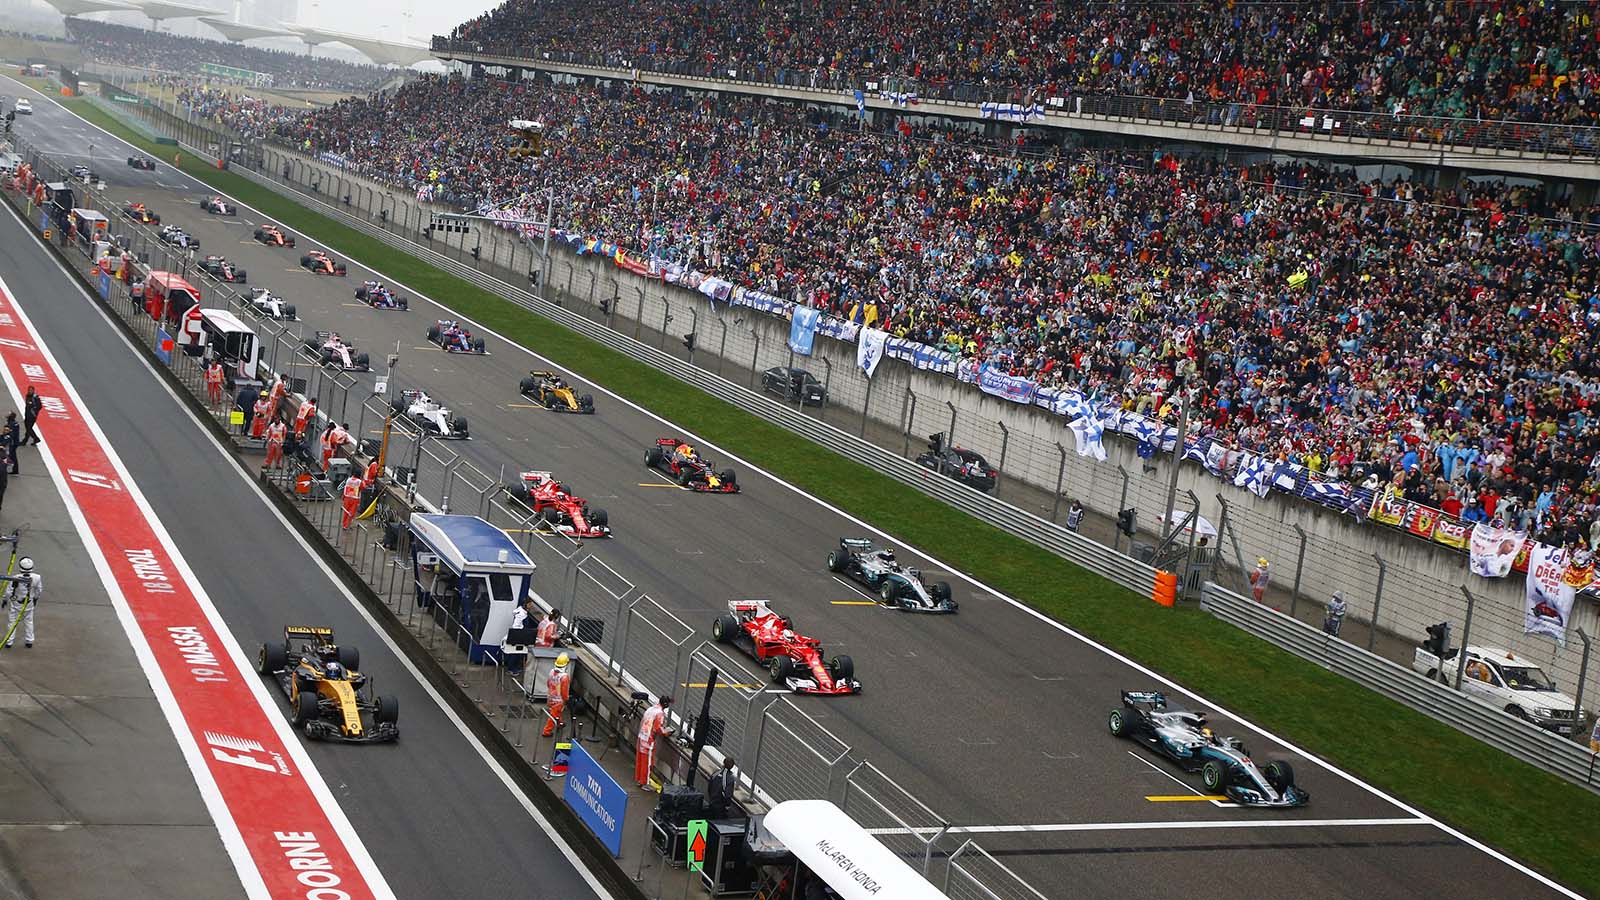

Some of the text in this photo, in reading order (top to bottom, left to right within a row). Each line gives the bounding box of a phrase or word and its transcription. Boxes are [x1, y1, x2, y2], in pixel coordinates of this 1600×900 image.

[124, 548, 176, 594] 18 STROLL
[1535, 565, 1563, 582] DREA
[167, 626, 230, 682] 19 MASSA
[570, 775, 616, 832] COMMUNICATIONS
[587, 773, 602, 799] TATA
[273, 831, 351, 900] OORNE
[816, 839, 882, 896] McLAREN HONDA
